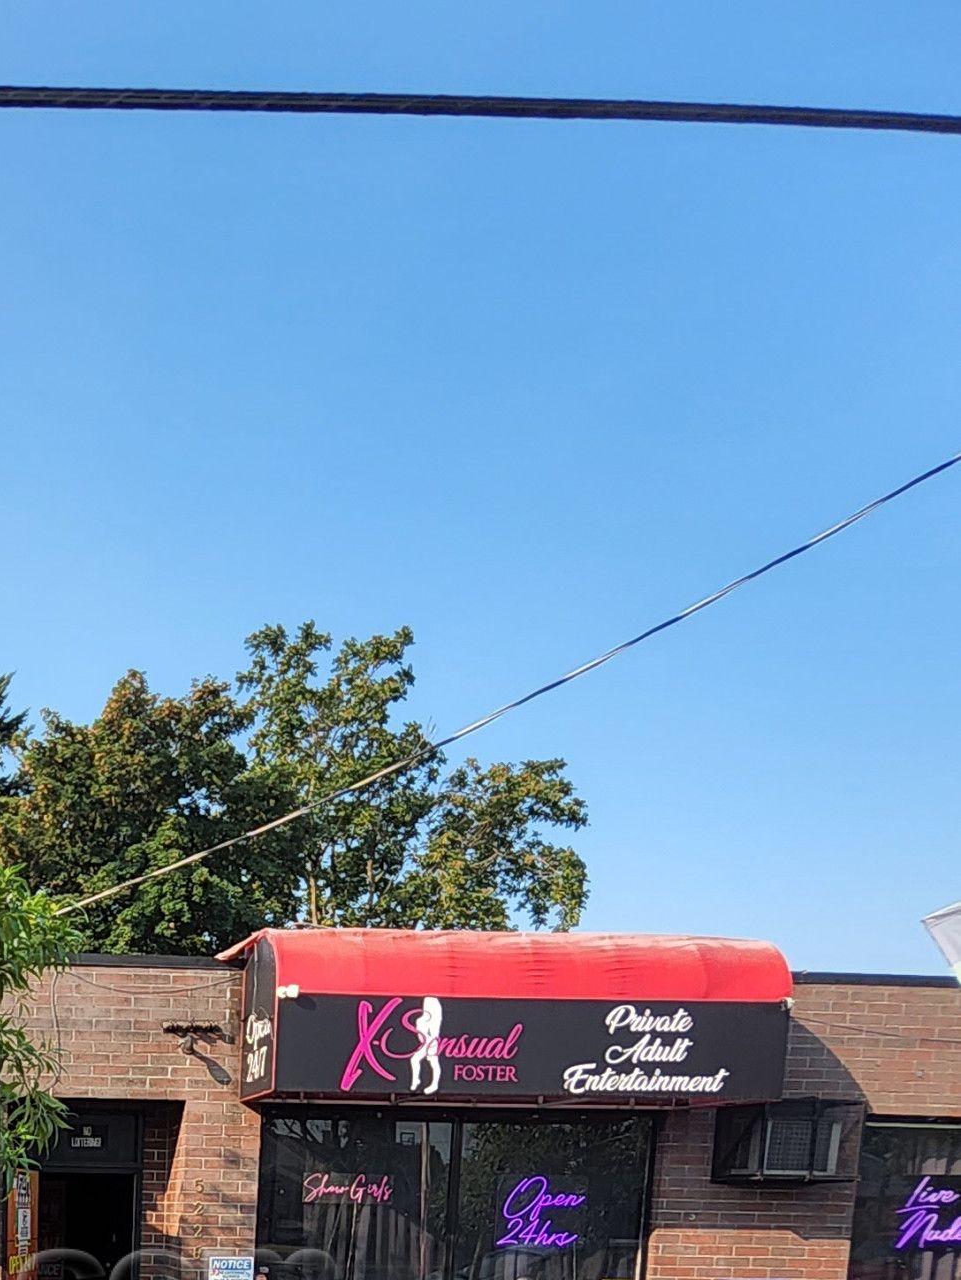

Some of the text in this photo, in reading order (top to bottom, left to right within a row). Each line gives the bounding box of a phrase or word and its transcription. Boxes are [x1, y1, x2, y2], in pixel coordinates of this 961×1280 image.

[246, 1014, 271, 1051] Open
[604, 1004, 694, 1035] Private
[604, 1033, 694, 1064] Adult
[453, 1064, 518, 1082] FOSTER
[563, 1063, 730, 1094] Entertainment
[303, 1173, 393, 1204] Show Girls
[502, 1175, 586, 1221] Open
[895, 1175, 960, 1213] Live
[496, 1217, 579, 1247] 24hrs
[895, 1209, 961, 1249] Nud
[212, 1259, 251, 1270] NOTICE
